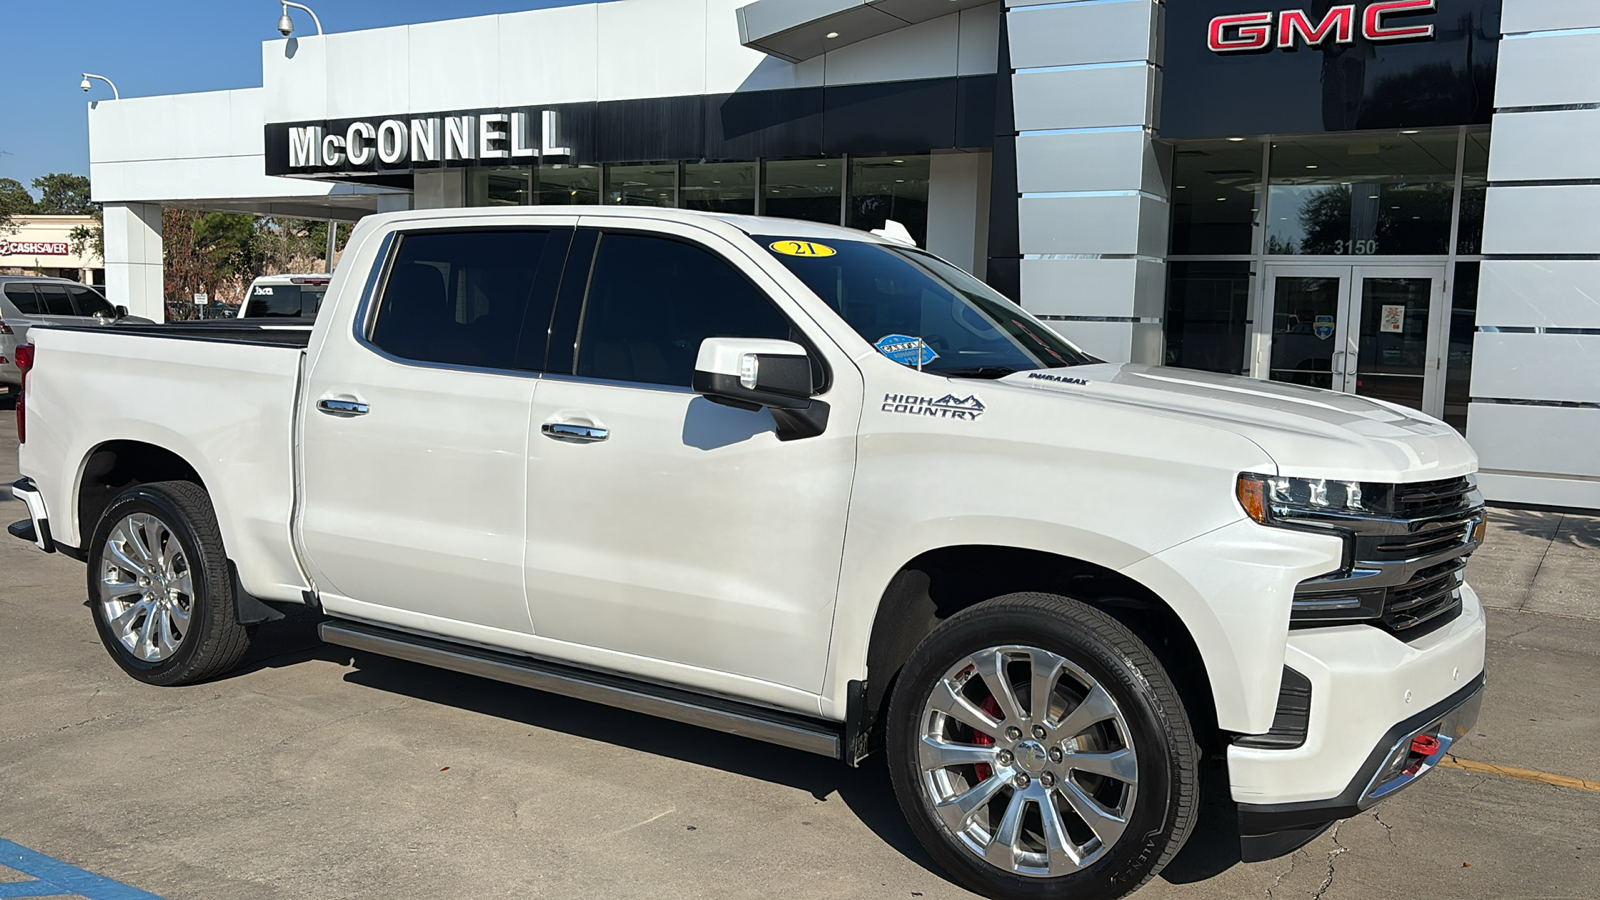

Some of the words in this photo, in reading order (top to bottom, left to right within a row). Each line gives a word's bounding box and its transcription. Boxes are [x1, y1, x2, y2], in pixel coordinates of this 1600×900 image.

[1207, 0, 1435, 52] GMC
[288, 110, 571, 168] McCONNELL
[789, 242, 819, 255] 21
[1333, 239, 1377, 255] 3150
[1028, 372, 1090, 386] DURAMAX
[883, 393, 933, 406] HIGH
[881, 403, 983, 421] COUNTRY
